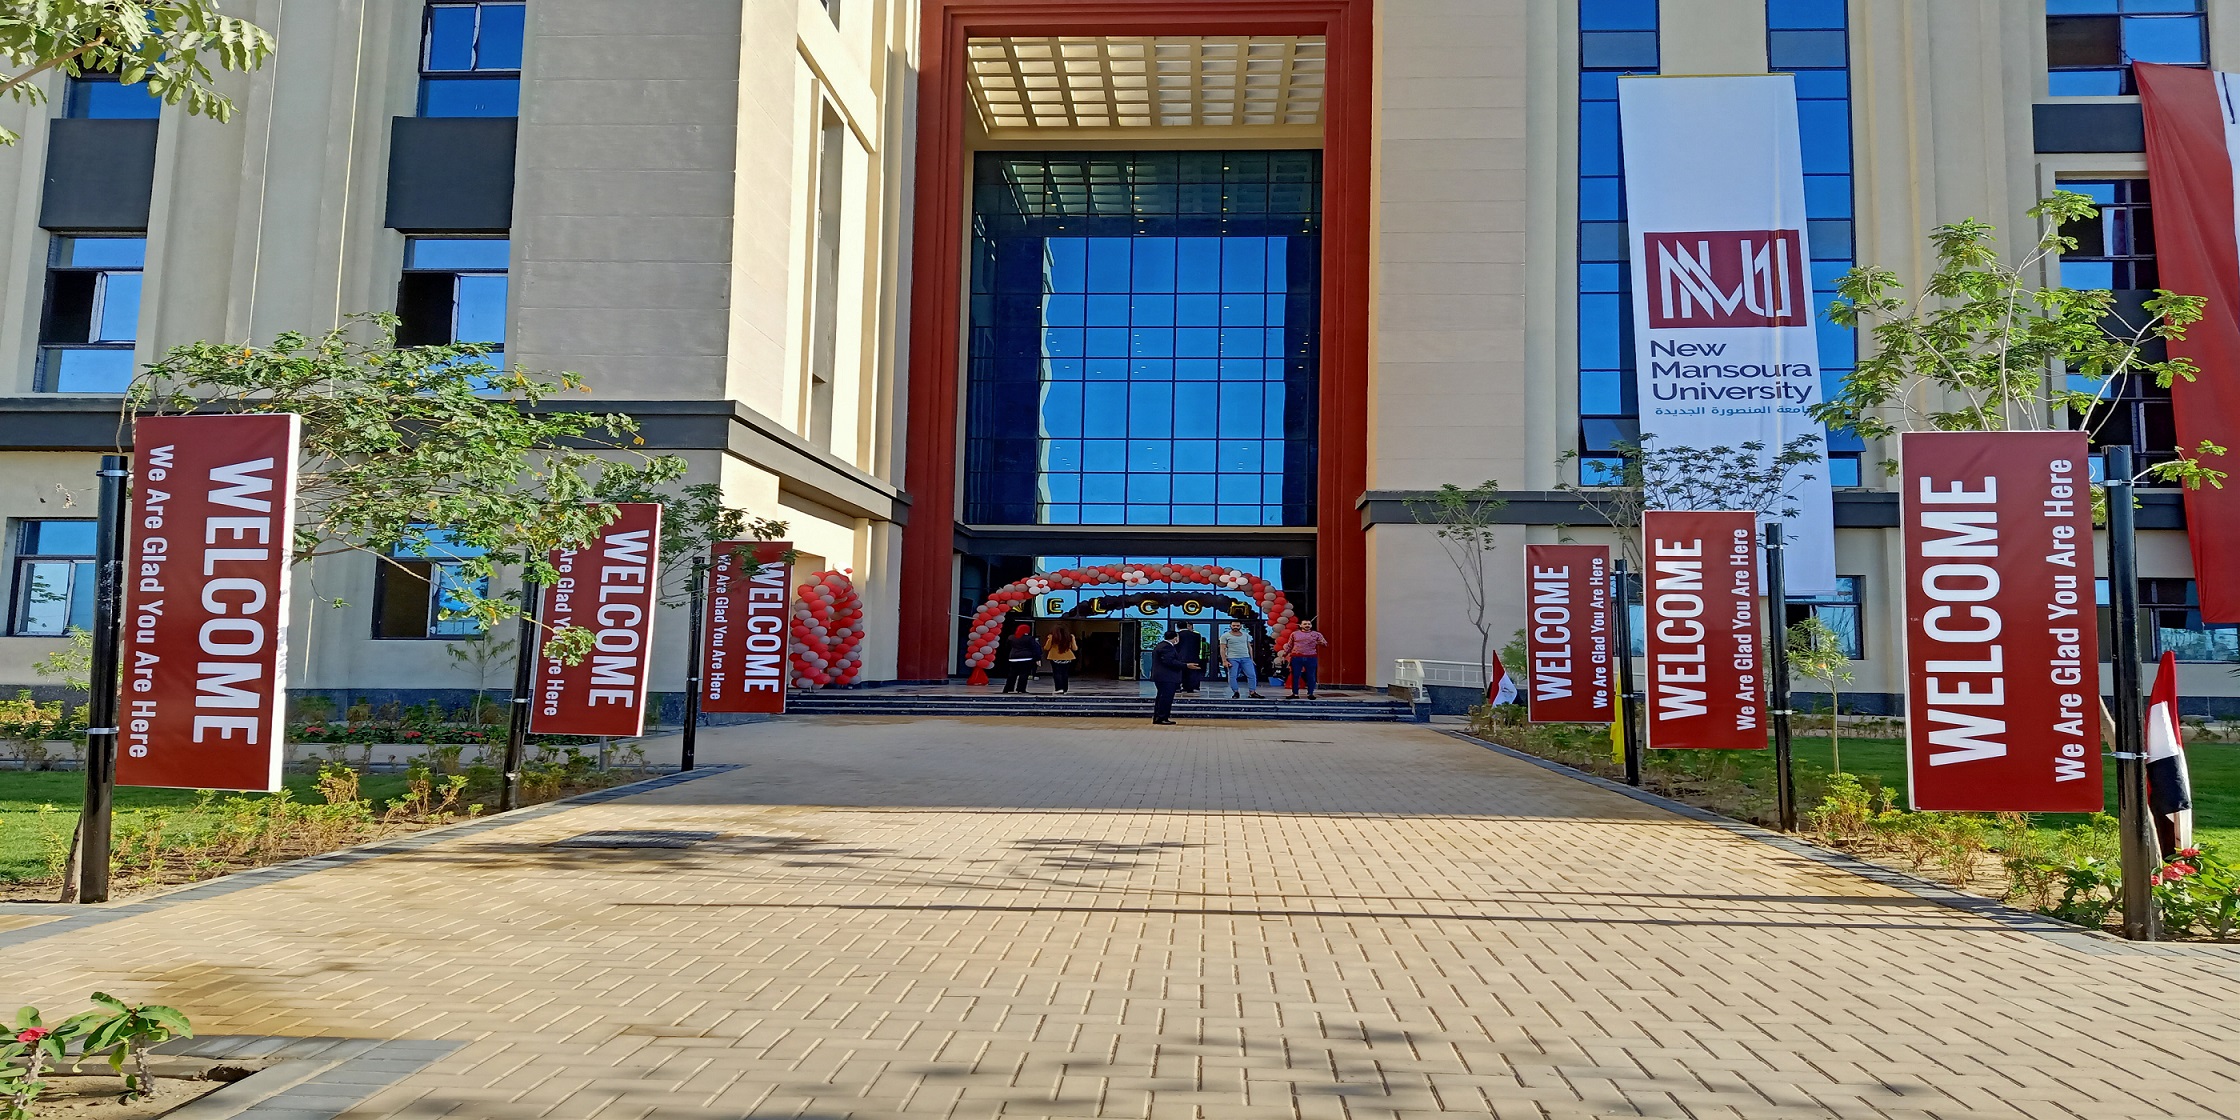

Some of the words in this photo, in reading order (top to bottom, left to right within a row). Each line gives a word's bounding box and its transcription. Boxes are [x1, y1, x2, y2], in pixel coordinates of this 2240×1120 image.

[1650, 339, 1728, 358] New
[1651, 360, 1813, 380] Mansoura
[1652, 381, 1813, 404] University
[1655, 406, 1705, 416] الجديدة
[1711, 405, 1771, 417] المنصورة
[148, 444, 175, 482] We
[2043, 459, 2075, 517] Here
[144, 488, 171, 529] Are
[140, 537, 168, 592] Glad
[1729, 529, 1749, 566] Here
[2045, 525, 2077, 568] Are
[715, 574, 731, 594] Are
[1589, 557, 1604, 586] Here
[1730, 570, 1751, 597] Are
[192, 456, 275, 745] WELCOME
[554, 577, 575, 613] Glad
[714, 596, 729, 623] Glad
[1589, 588, 1604, 609] Are
[2047, 575, 2078, 621] You
[136, 599, 164, 644] You
[588, 529, 650, 708] WELCOME
[743, 561, 785, 693] WELCOME
[1533, 565, 1572, 702] WELCOME
[1590, 611, 1605, 634] You
[1654, 538, 1707, 721] WELCOME
[1732, 601, 1752, 630] You
[1919, 475, 2007, 767] WELCOME
[712, 625, 728, 647] You
[1591, 636, 1607, 664] Glad
[1733, 633, 1754, 670] Glad
[133, 650, 160, 693] Are
[548, 651, 567, 675] re
[711, 649, 727, 670] Are
[2050, 628, 2082, 686] Glad
[709, 672, 725, 700] Here
[1592, 666, 1607, 687] Are
[1735, 674, 1755, 702] Are
[543, 679, 565, 716] Here
[1592, 689, 1608, 709] We
[2053, 693, 2084, 737] Are
[129, 700, 157, 758] Here
[1736, 706, 1757, 731] We
[2055, 743, 2086, 783] We
